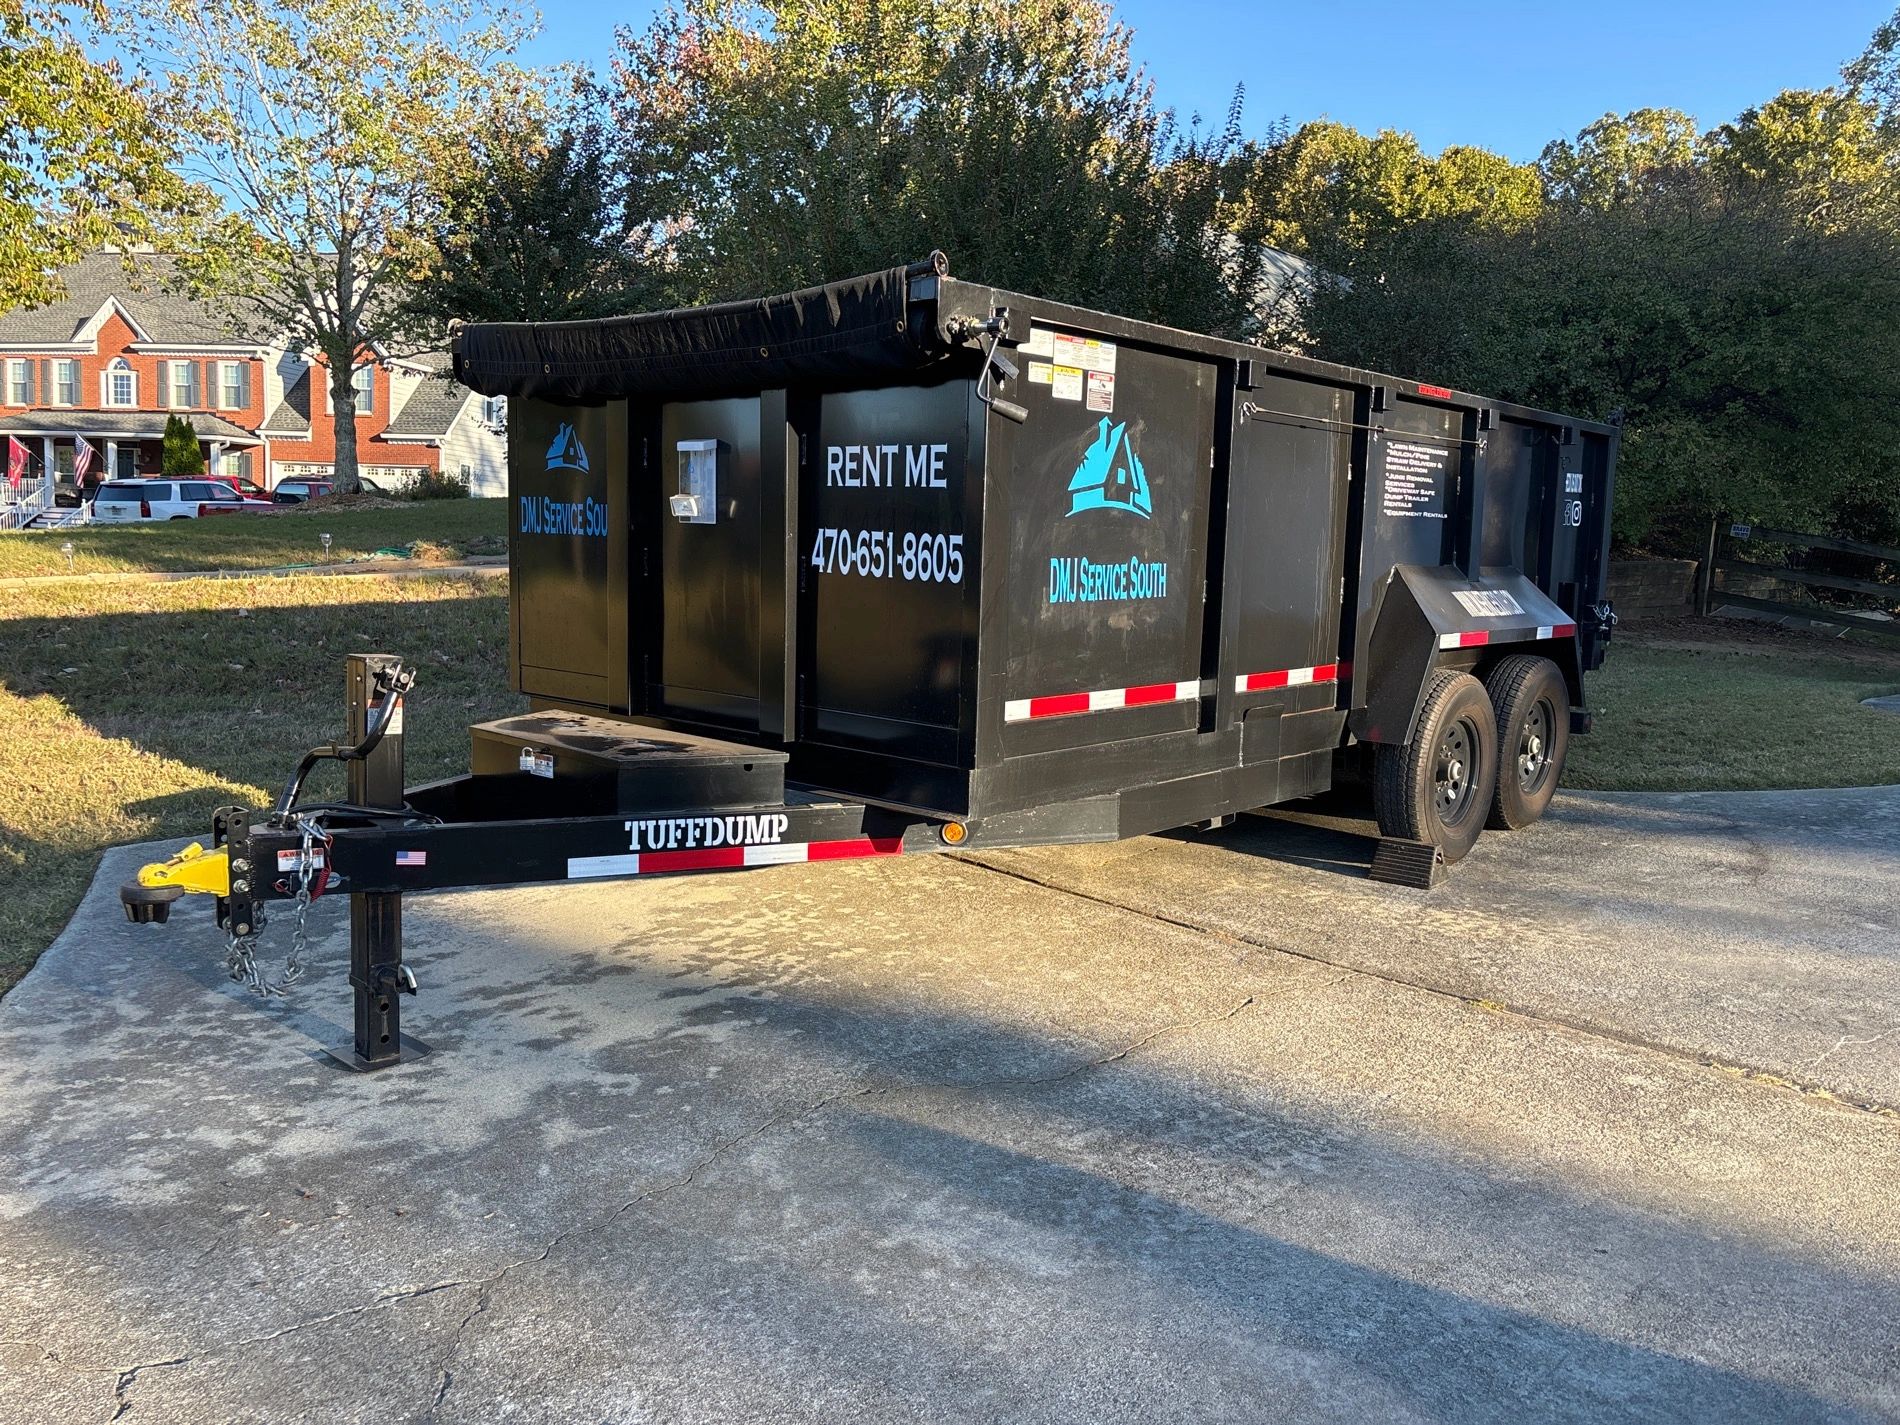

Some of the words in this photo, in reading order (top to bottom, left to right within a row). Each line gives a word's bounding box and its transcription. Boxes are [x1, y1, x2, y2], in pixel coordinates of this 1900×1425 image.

[827, 444, 899, 488] RENT
[905, 443, 948, 488] ME
[1386, 463, 1428, 474] INSTALLATION
[1409, 459, 1437, 468] DELIVERY
[1385, 480, 1415, 488] SERVICES
[1406, 475, 1434, 484] REMOVAL
[1384, 500, 1413, 508] RENTALS
[521, 496, 542, 534] DMJ
[543, 496, 584, 535] SERVICE
[586, 496, 608, 537] SOU
[811, 527, 964, 584] 470-651-8605
[1049, 557, 1078, 604] DMJ
[1079, 556, 1128, 602] SERVICE
[1129, 555, 1167, 600] SOUTH
[625, 813, 788, 850] TUFFDUMP
